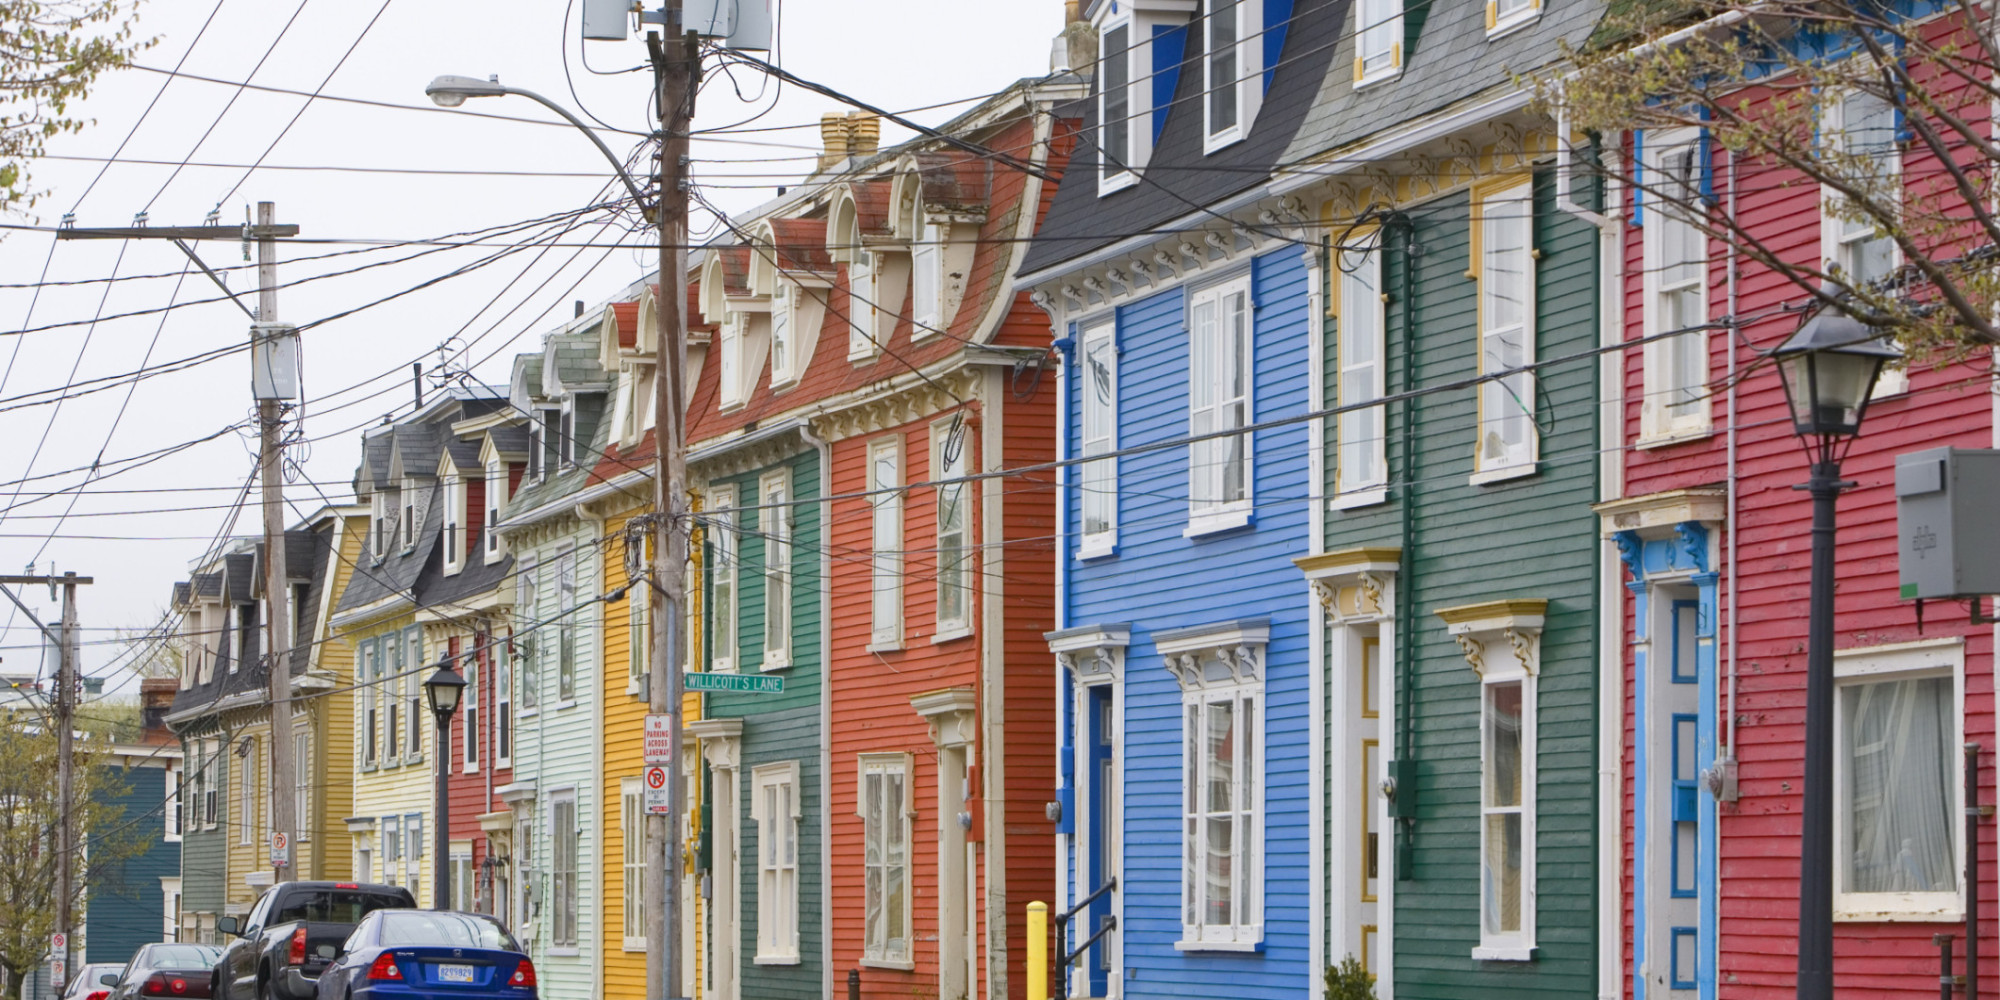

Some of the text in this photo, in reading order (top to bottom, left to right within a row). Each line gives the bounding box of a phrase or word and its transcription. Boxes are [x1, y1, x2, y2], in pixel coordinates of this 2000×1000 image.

[688, 675, 780, 691] WILLICOTT'S LANE
[646, 730, 668, 738] PARKING
